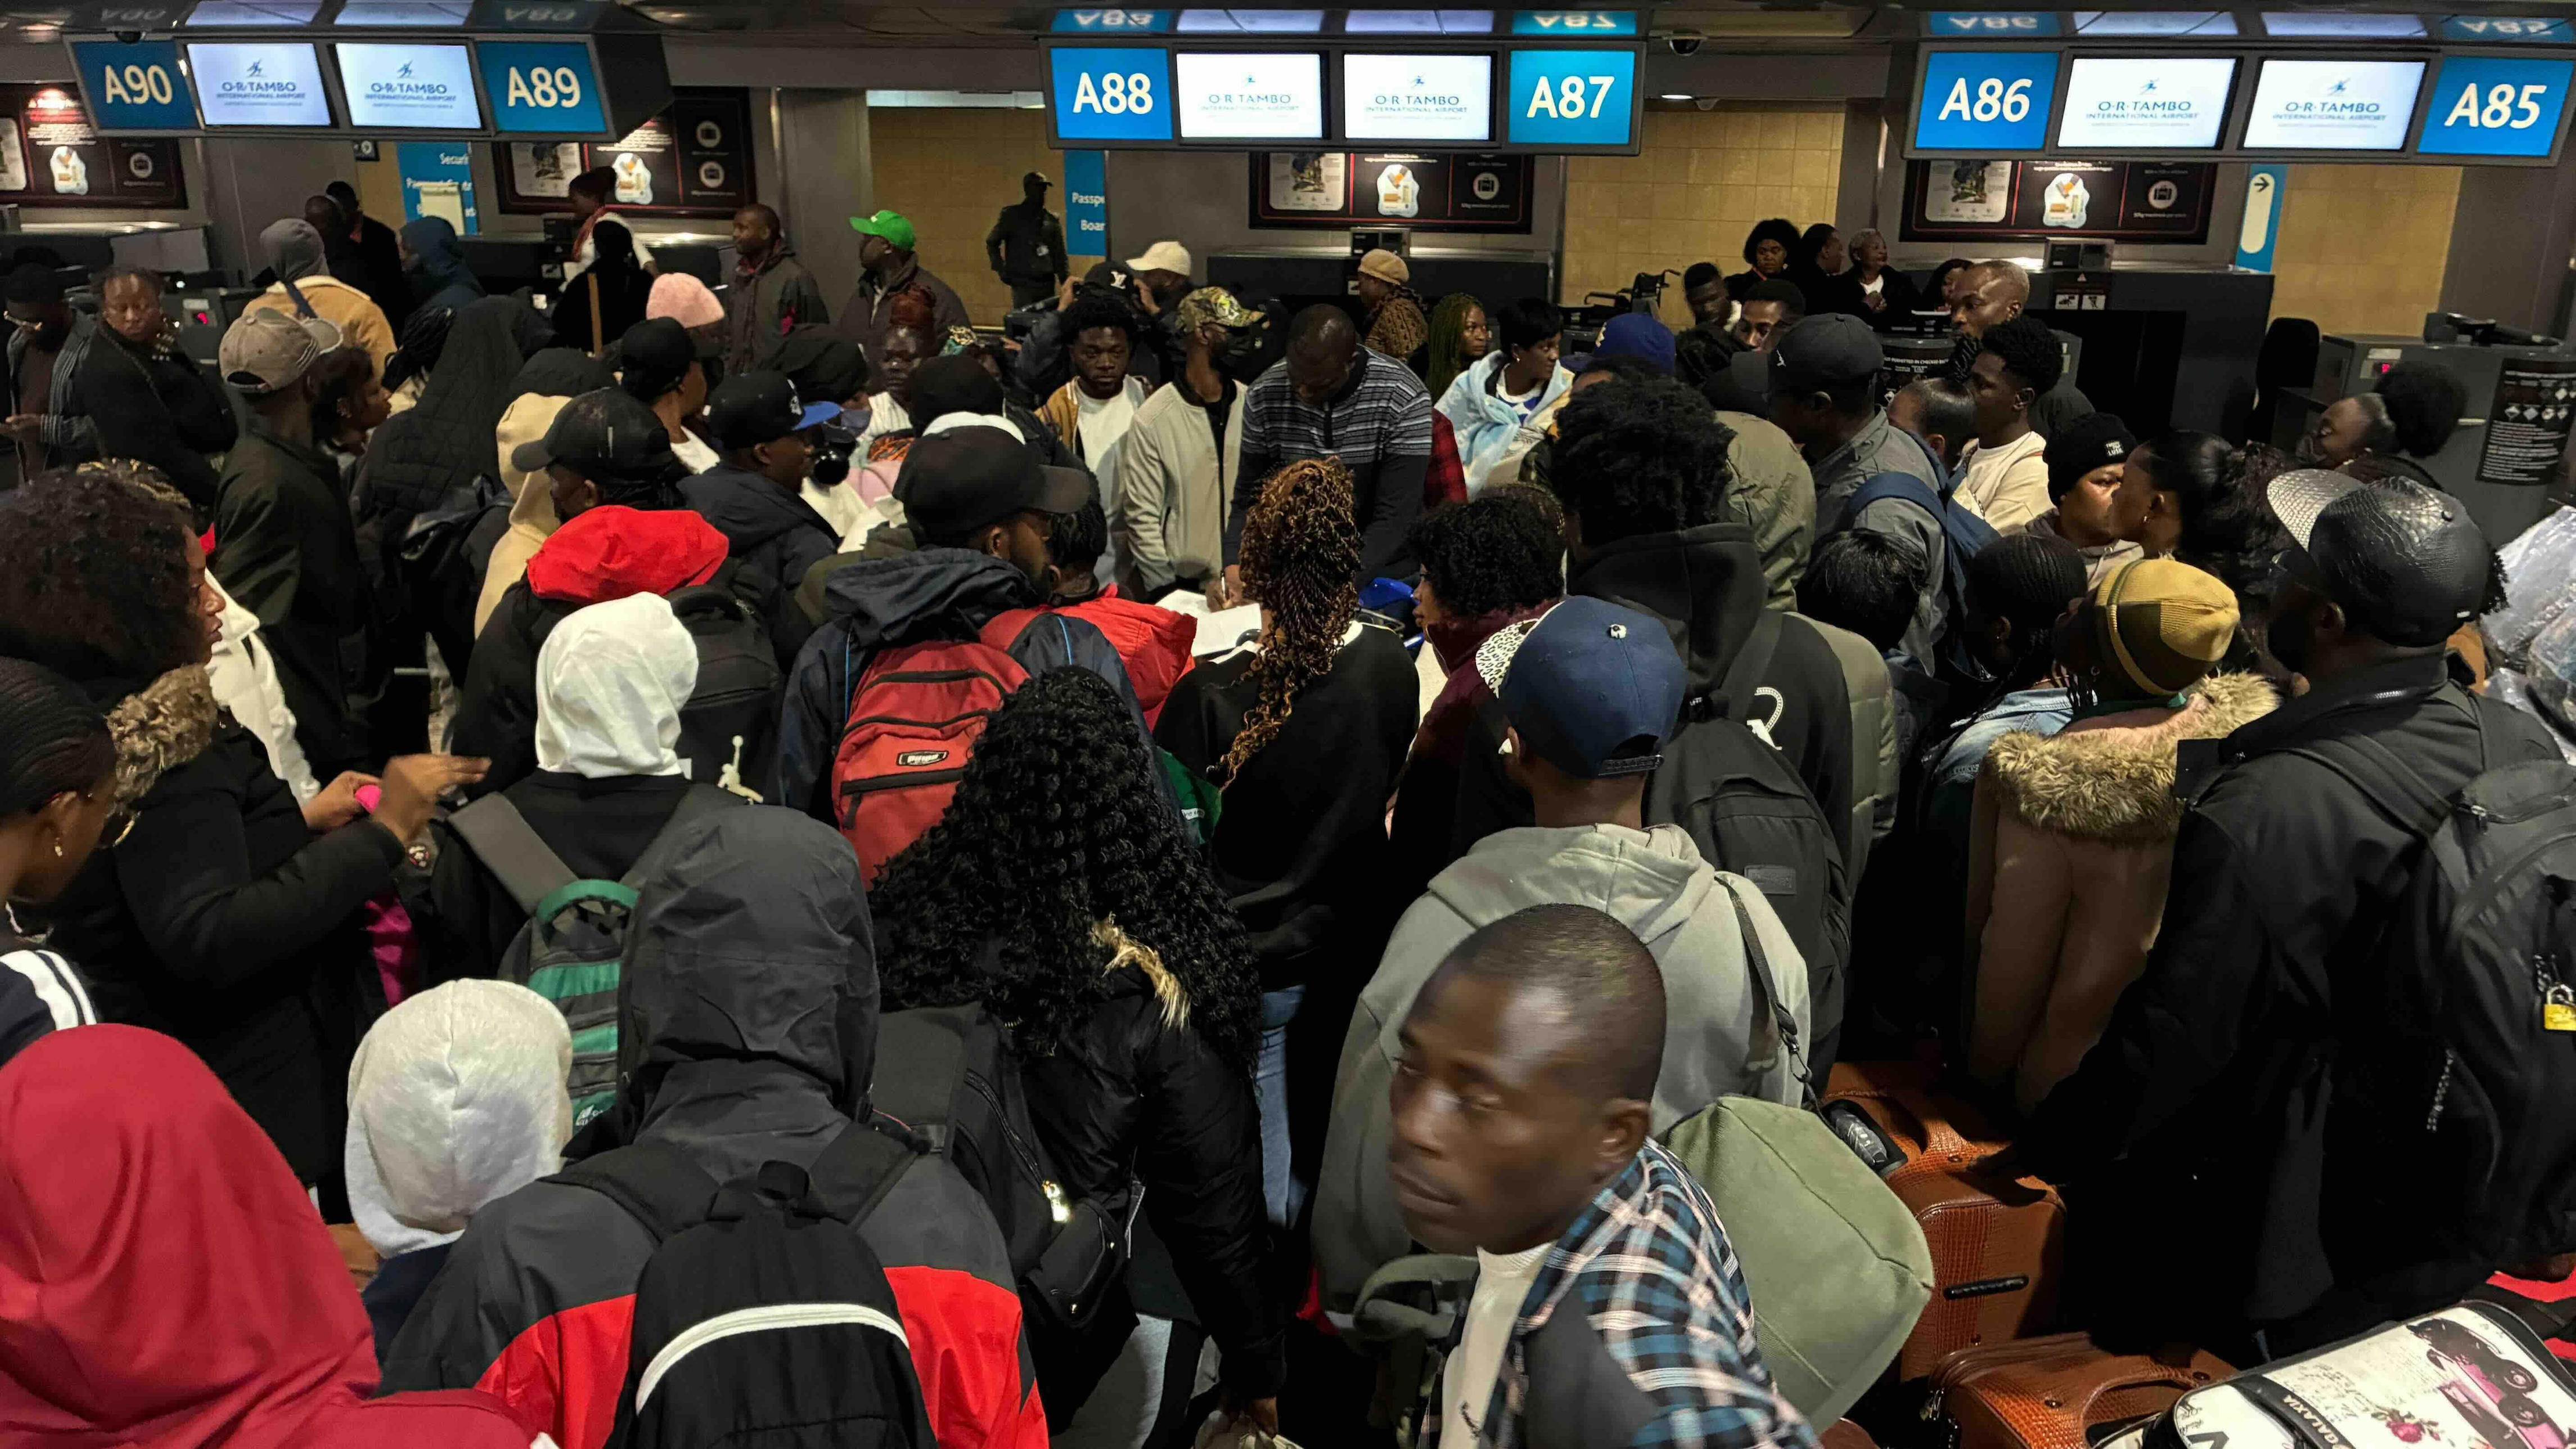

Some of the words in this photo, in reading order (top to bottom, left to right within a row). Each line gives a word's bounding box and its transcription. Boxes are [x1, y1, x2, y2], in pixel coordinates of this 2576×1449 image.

[105, 65, 173, 105] A90
[508, 67, 580, 108] A89
[1073, 72, 1153, 115] A88
[1526, 75, 1615, 119] A87
[1938, 77, 2033, 123] A86
[2444, 83, 2547, 129] A85
